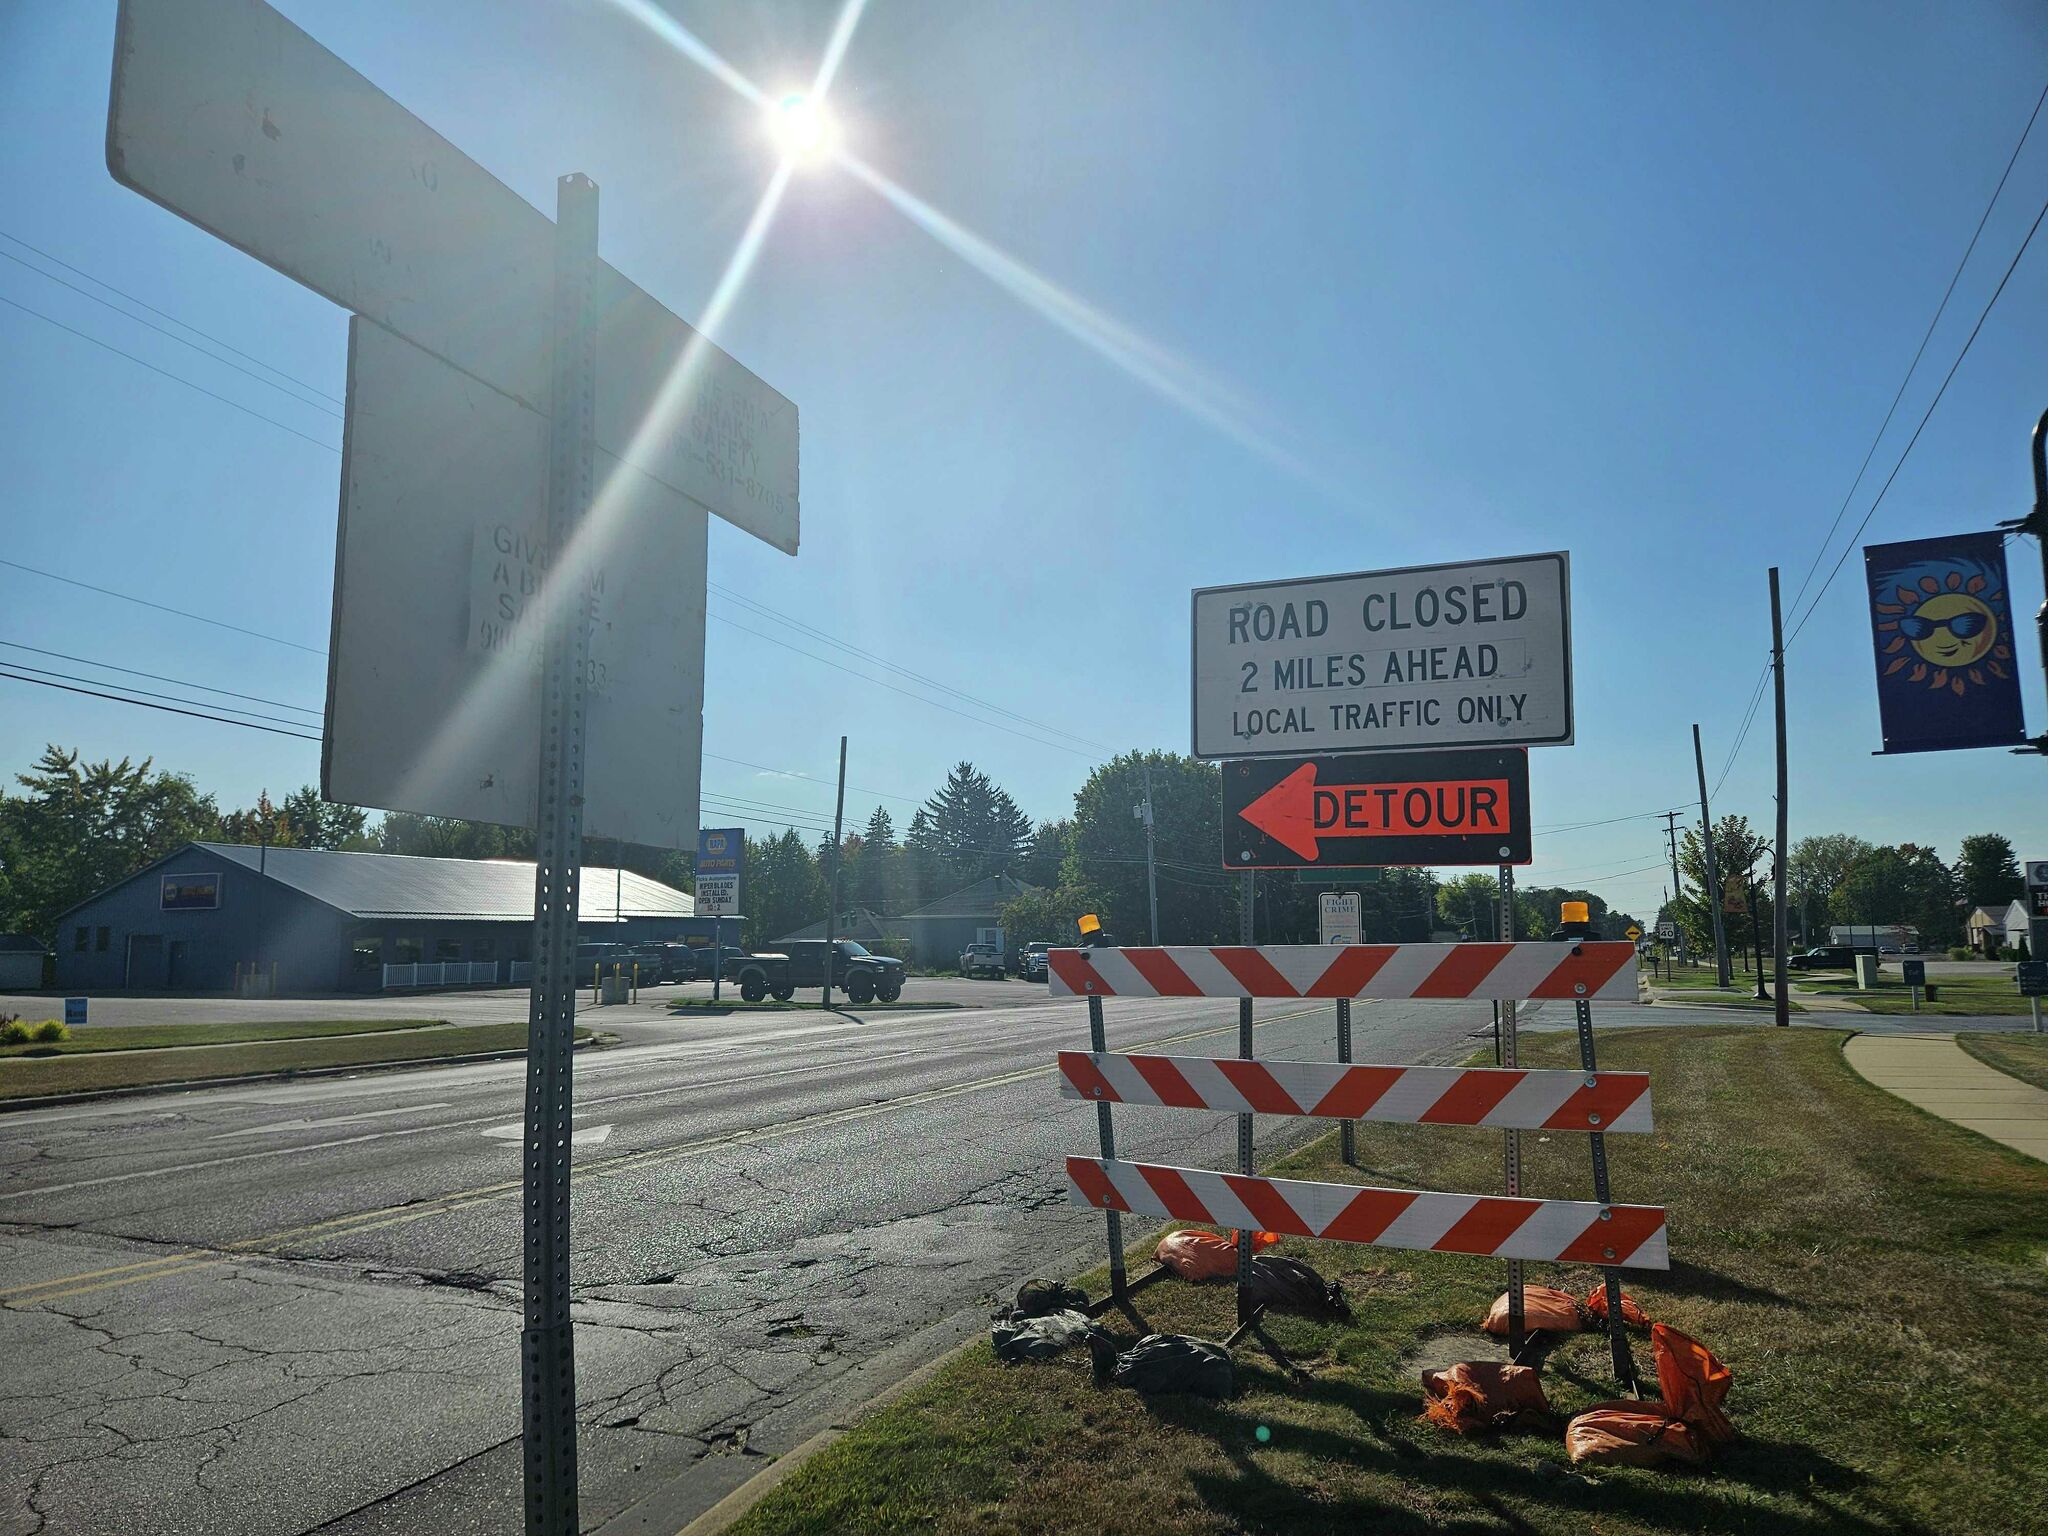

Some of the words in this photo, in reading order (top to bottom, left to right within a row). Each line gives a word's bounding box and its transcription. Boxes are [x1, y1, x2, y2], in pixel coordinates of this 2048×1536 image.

[691, 415, 761, 476] SAFETY
[1229, 599, 1329, 644] ROAD
[1362, 580, 1528, 633] CLOSED
[1241, 661, 1258, 693] 2
[1274, 654, 1366, 691] MILES
[1384, 644, 1499, 684] AHEAD
[1233, 706, 1315, 737] LOCAL
[1330, 698, 1441, 731] TRAFFIC
[1458, 694, 1528, 724] ONLY
[1313, 786, 1499, 829] DETOUR
